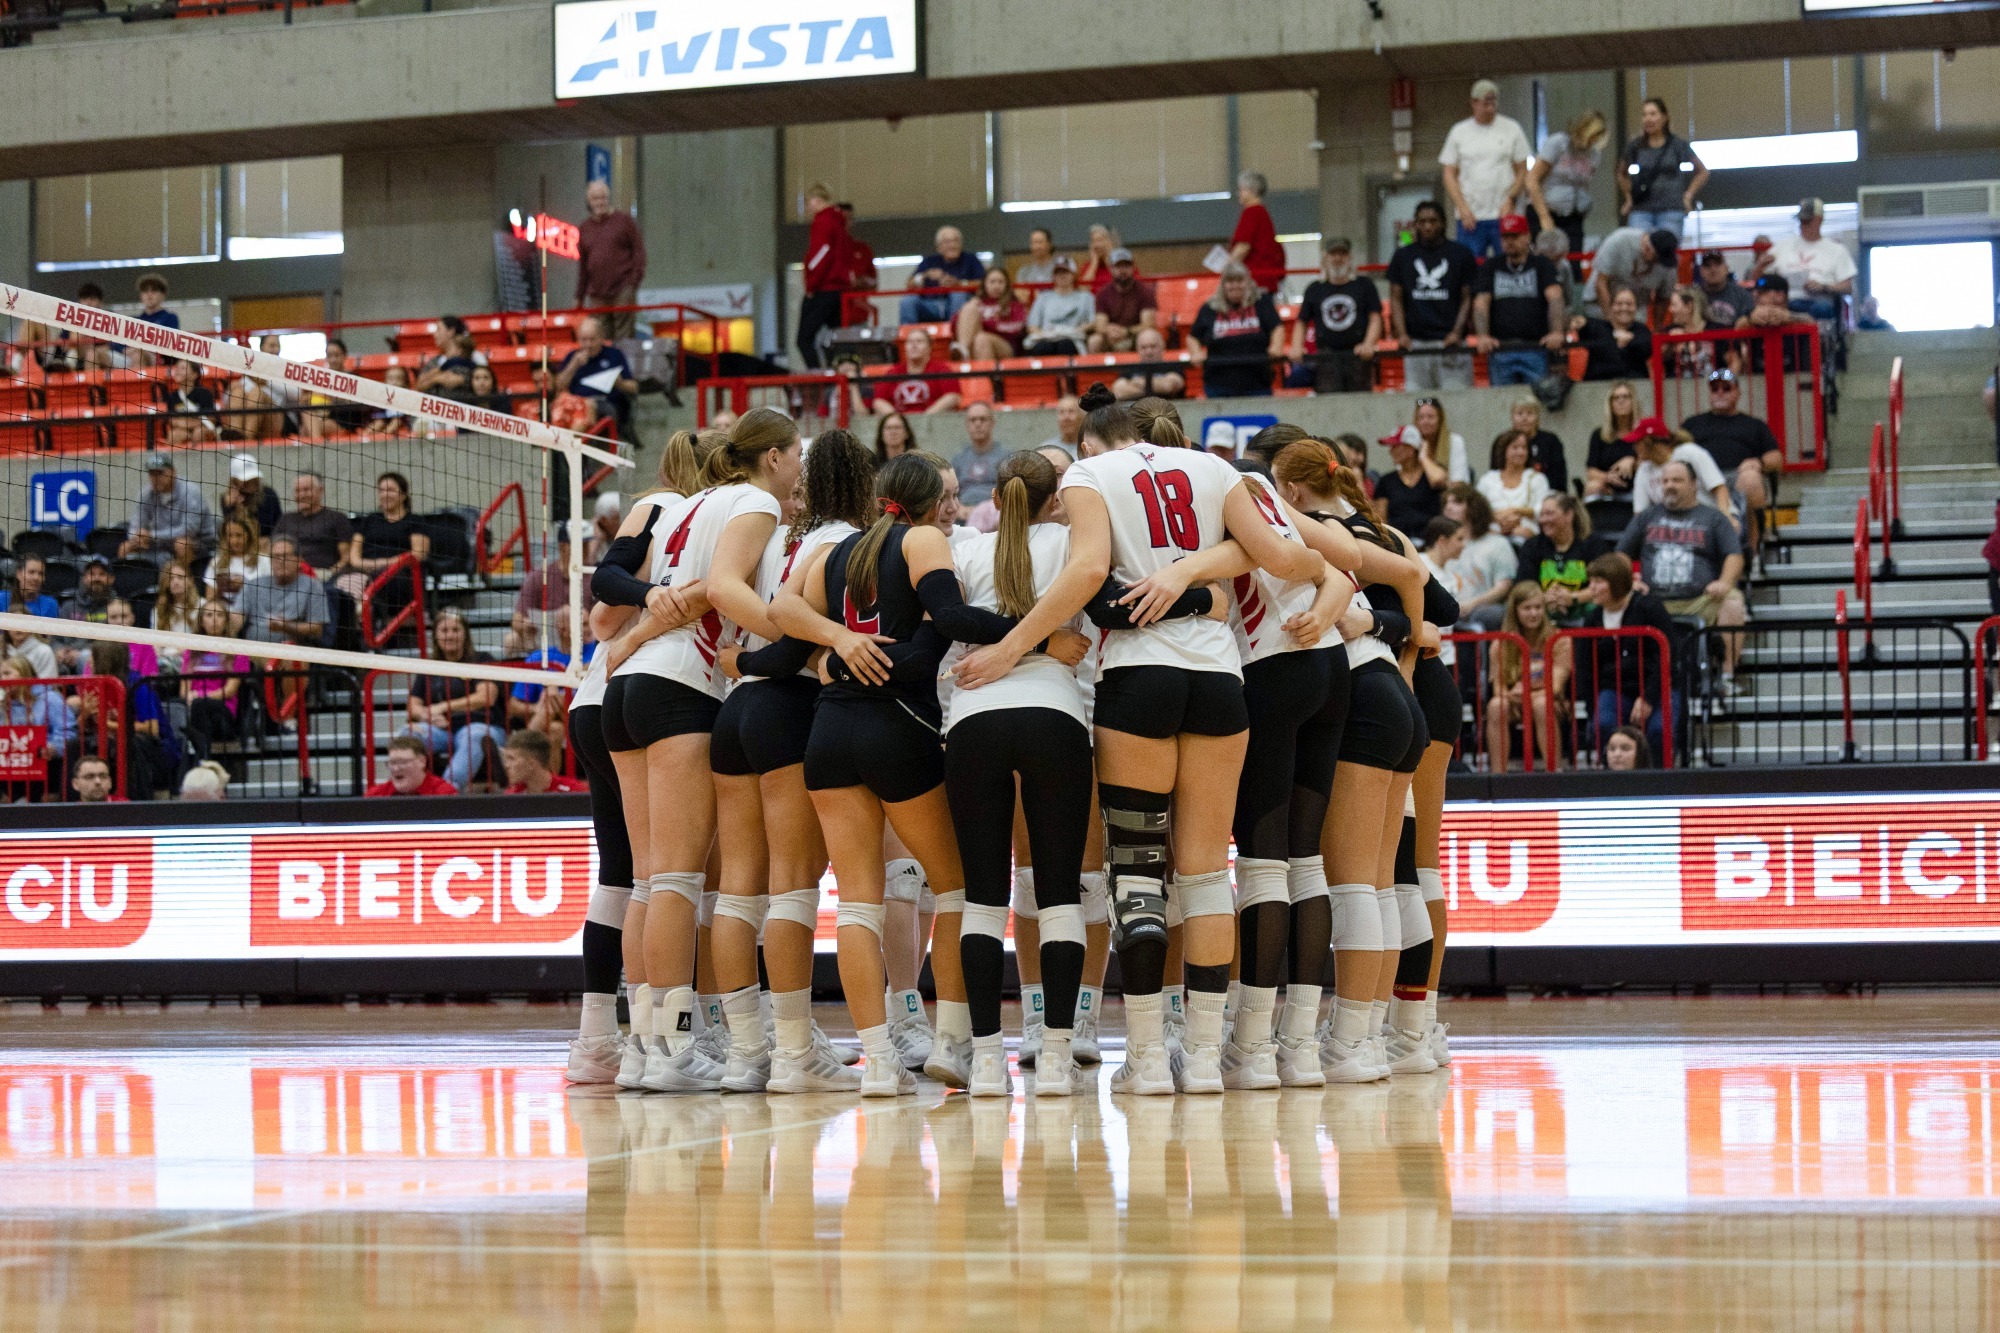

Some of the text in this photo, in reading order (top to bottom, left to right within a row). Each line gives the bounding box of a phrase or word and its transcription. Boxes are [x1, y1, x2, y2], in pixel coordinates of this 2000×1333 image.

[569, 11, 894, 83] AVISTA
[55, 302, 212, 359] EASTERN WASHINGTON
[284, 361, 359, 396] GOEAGS.COM
[420, 396, 531, 437] EASTERN WASHINGTON
[35, 479, 90, 522] LC
[1132, 469, 1200, 551] 18
[664, 498, 705, 567] 4
[1714, 831, 2000, 901] BEC
